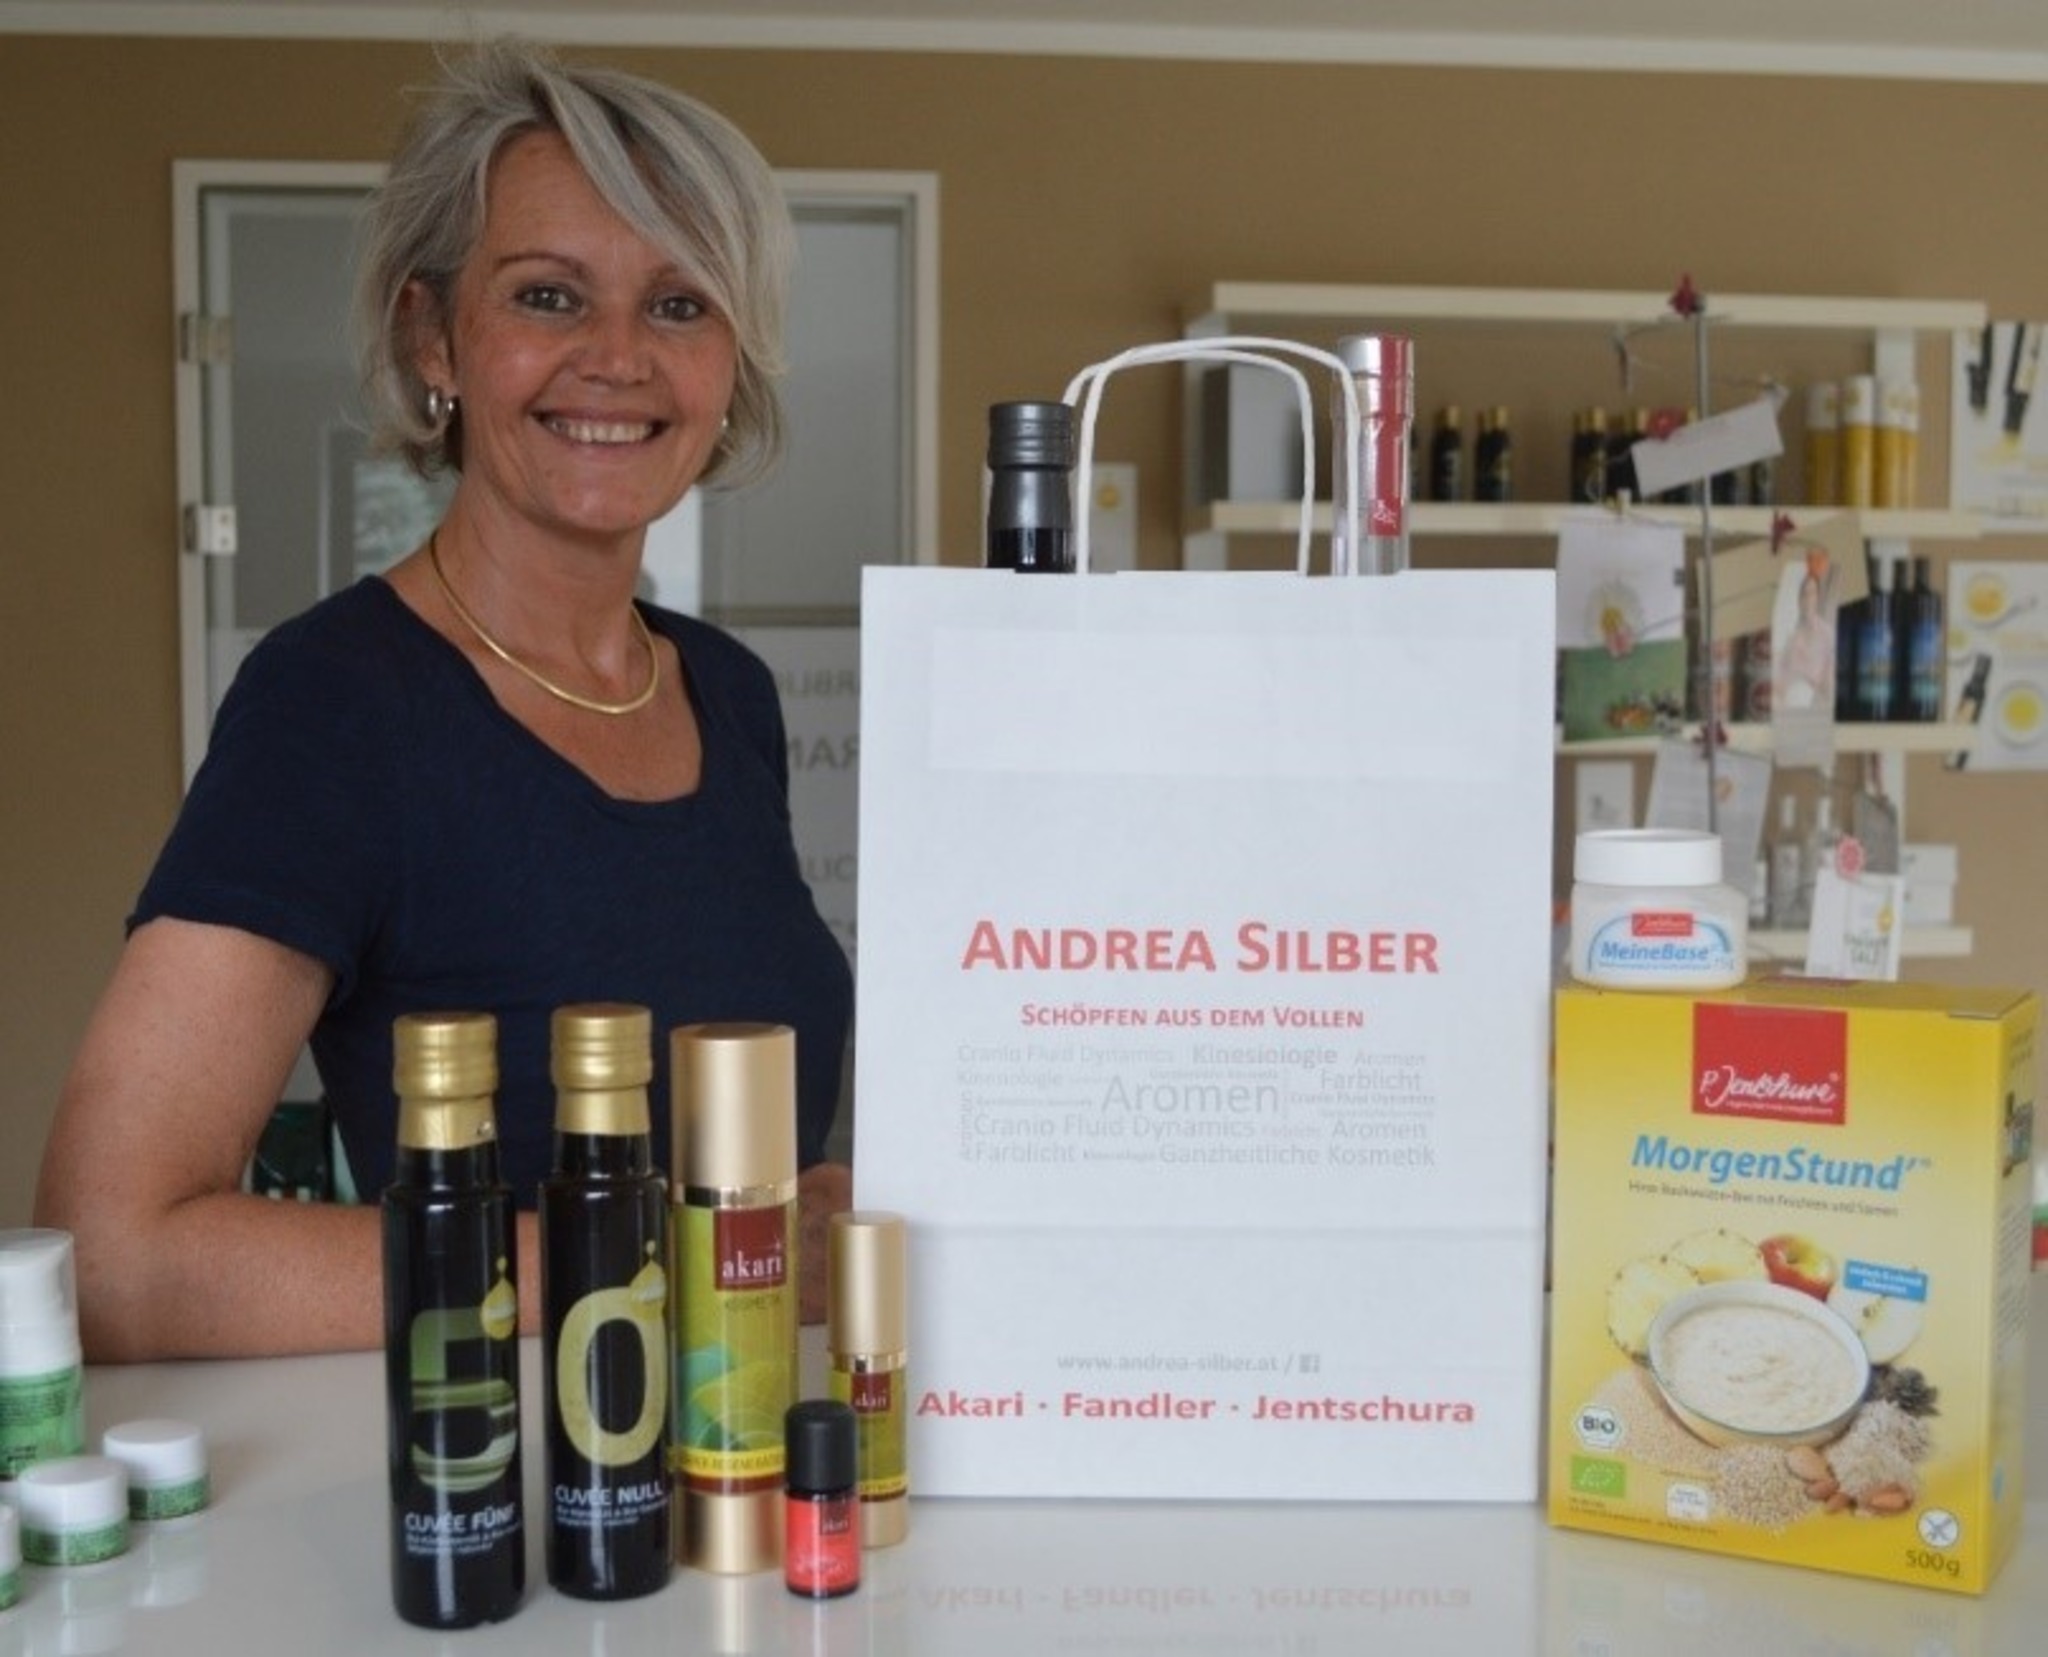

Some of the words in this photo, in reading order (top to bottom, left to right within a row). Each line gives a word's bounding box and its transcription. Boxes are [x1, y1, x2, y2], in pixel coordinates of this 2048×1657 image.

[961, 920, 1217, 971] ANDREA
[1237, 921, 1440, 974] SILBER
[1601, 941, 1709, 961] MeineBase
[1020, 1002, 1148, 1028] SCHÖPFEN
[1155, 1008, 1201, 1028] AUS
[1210, 1009, 1265, 1028] DEM
[1273, 1005, 1364, 1029] VOLLEN
[1192, 1044, 1338, 1069] Kinesiologie
[1320, 1069, 1421, 1091] Farblicht
[1101, 1075, 1279, 1113] Aromen
[973, 1113, 1055, 1136] Cranio
[1063, 1113, 1124, 1136] Fluid
[1132, 1113, 1256, 1141] Dynamics
[1332, 1119, 1427, 1139] Aromen
[976, 1141, 1078, 1163] Farblicht
[1159, 1143, 1320, 1165] Ganzheitliche
[1328, 1144, 1436, 1166] Kosmetik
[722, 1244, 783, 1281] akari
[1056, 1354, 1278, 1374] www.andrea-silber.at
[916, 1390, 1024, 1418] Akari
[1062, 1391, 1218, 1420] Fandler
[1252, 1394, 1475, 1423] Jentschura
[617, 1480, 664, 1504] NULL
[470, 1502, 516, 1530] FÜNF
